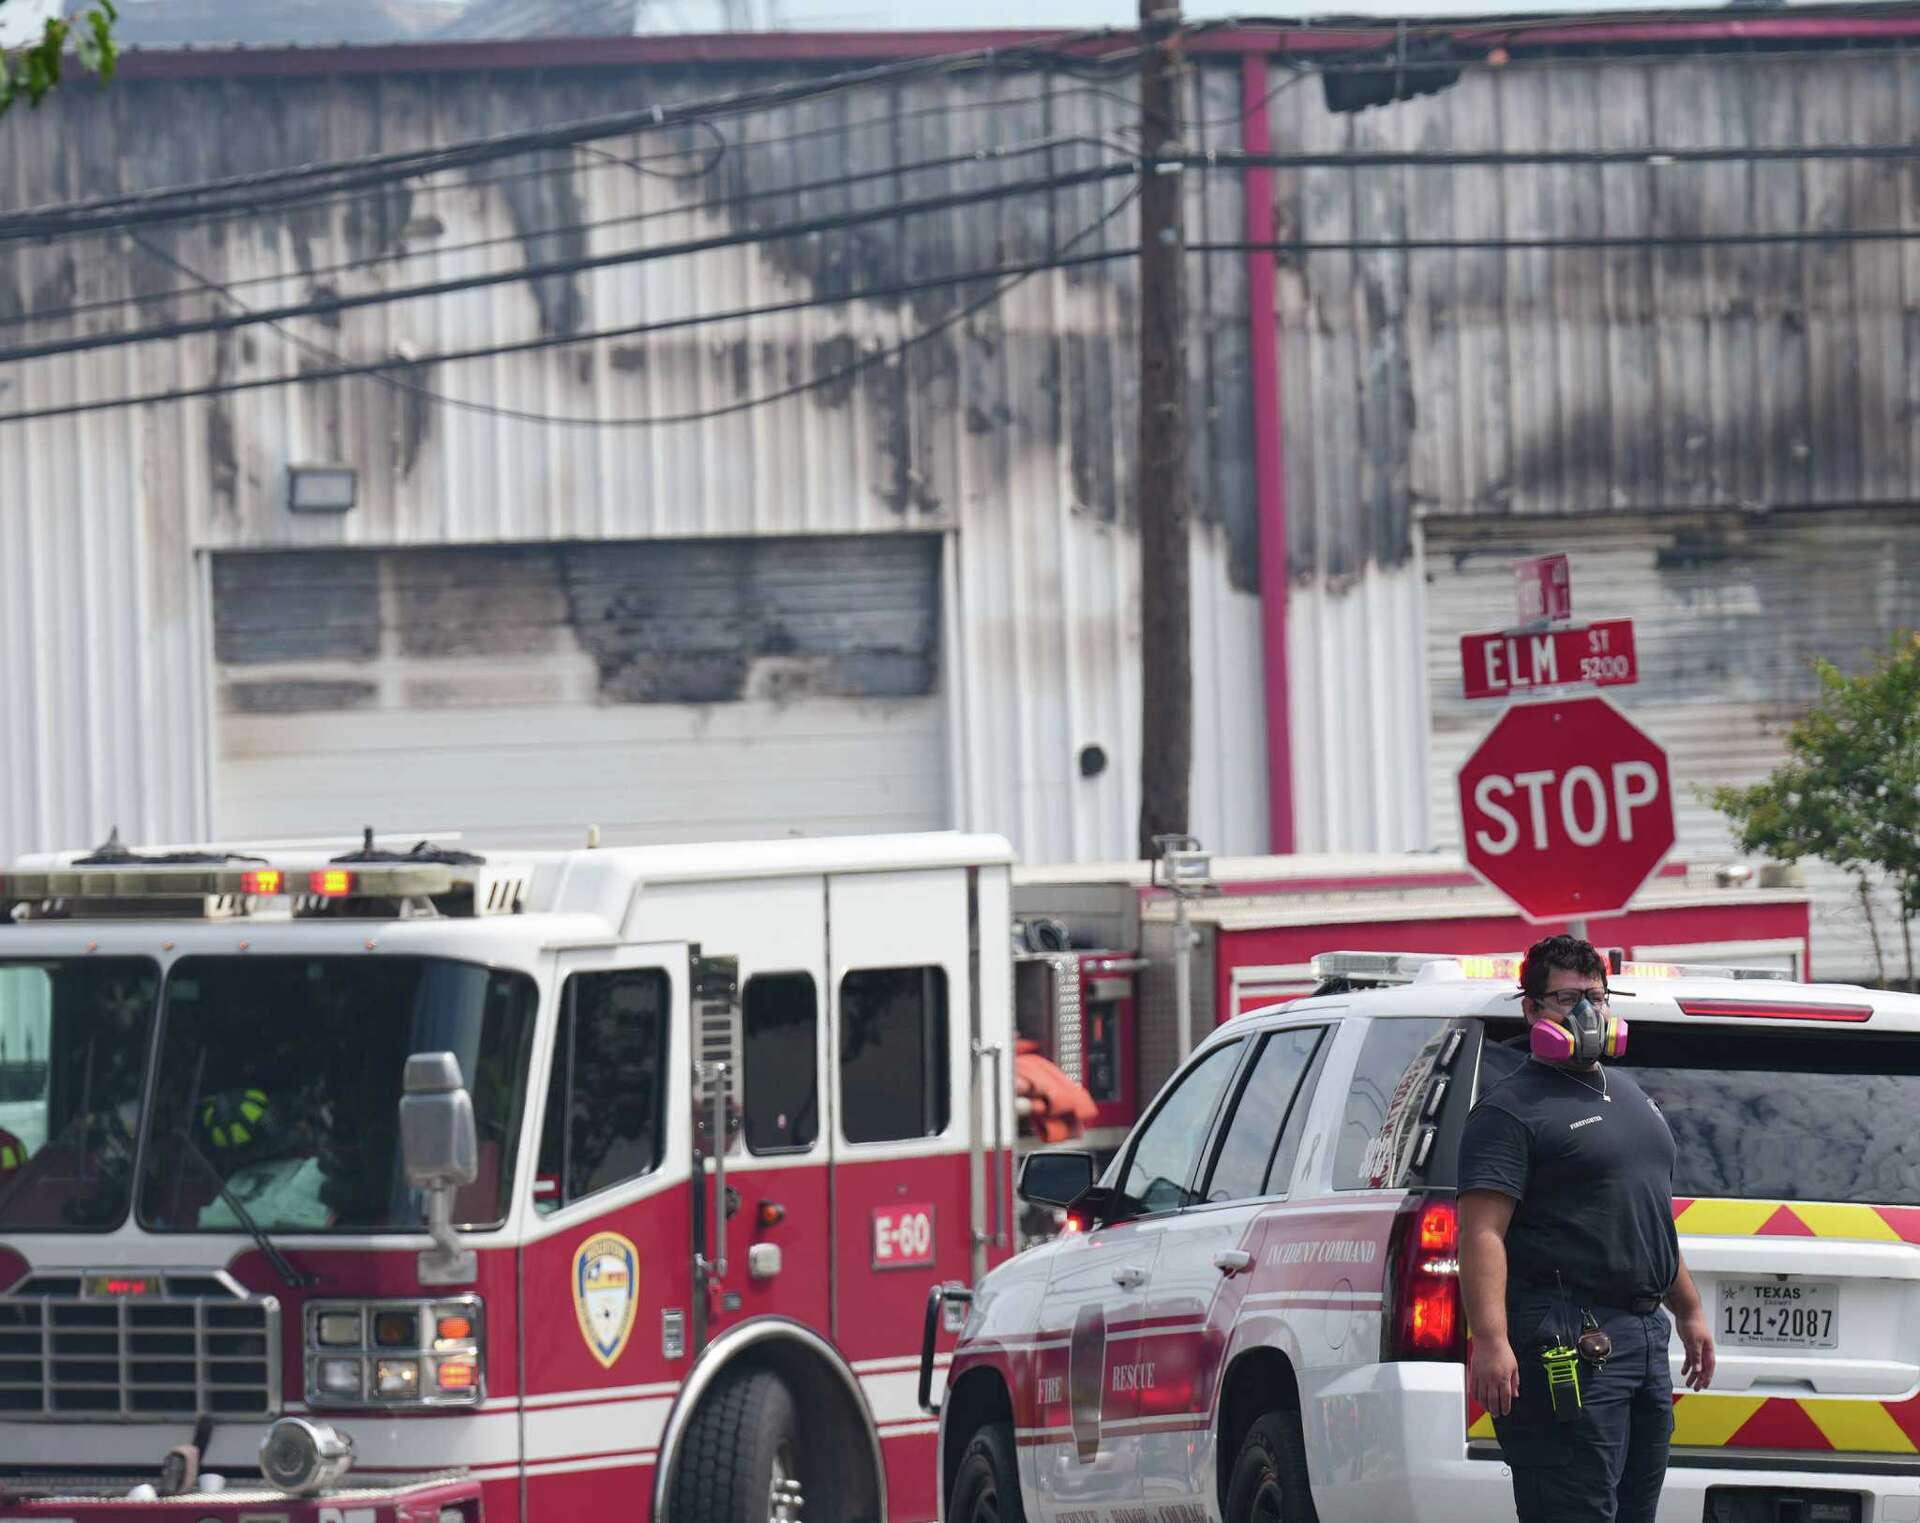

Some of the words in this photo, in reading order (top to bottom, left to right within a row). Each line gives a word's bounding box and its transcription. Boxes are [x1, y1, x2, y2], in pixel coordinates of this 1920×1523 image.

[1484, 634, 1559, 688] ELM
[1588, 629, 1609, 653] ST
[1580, 655, 1629, 680] 5200
[1474, 760, 1659, 855] STOP
[876, 1212, 930, 1257] E-60
[1754, 1286, 1801, 1300] TEXAS
[1038, 1376, 1063, 1404] FIRE
[1112, 1362, 1156, 1392] RESCUE
